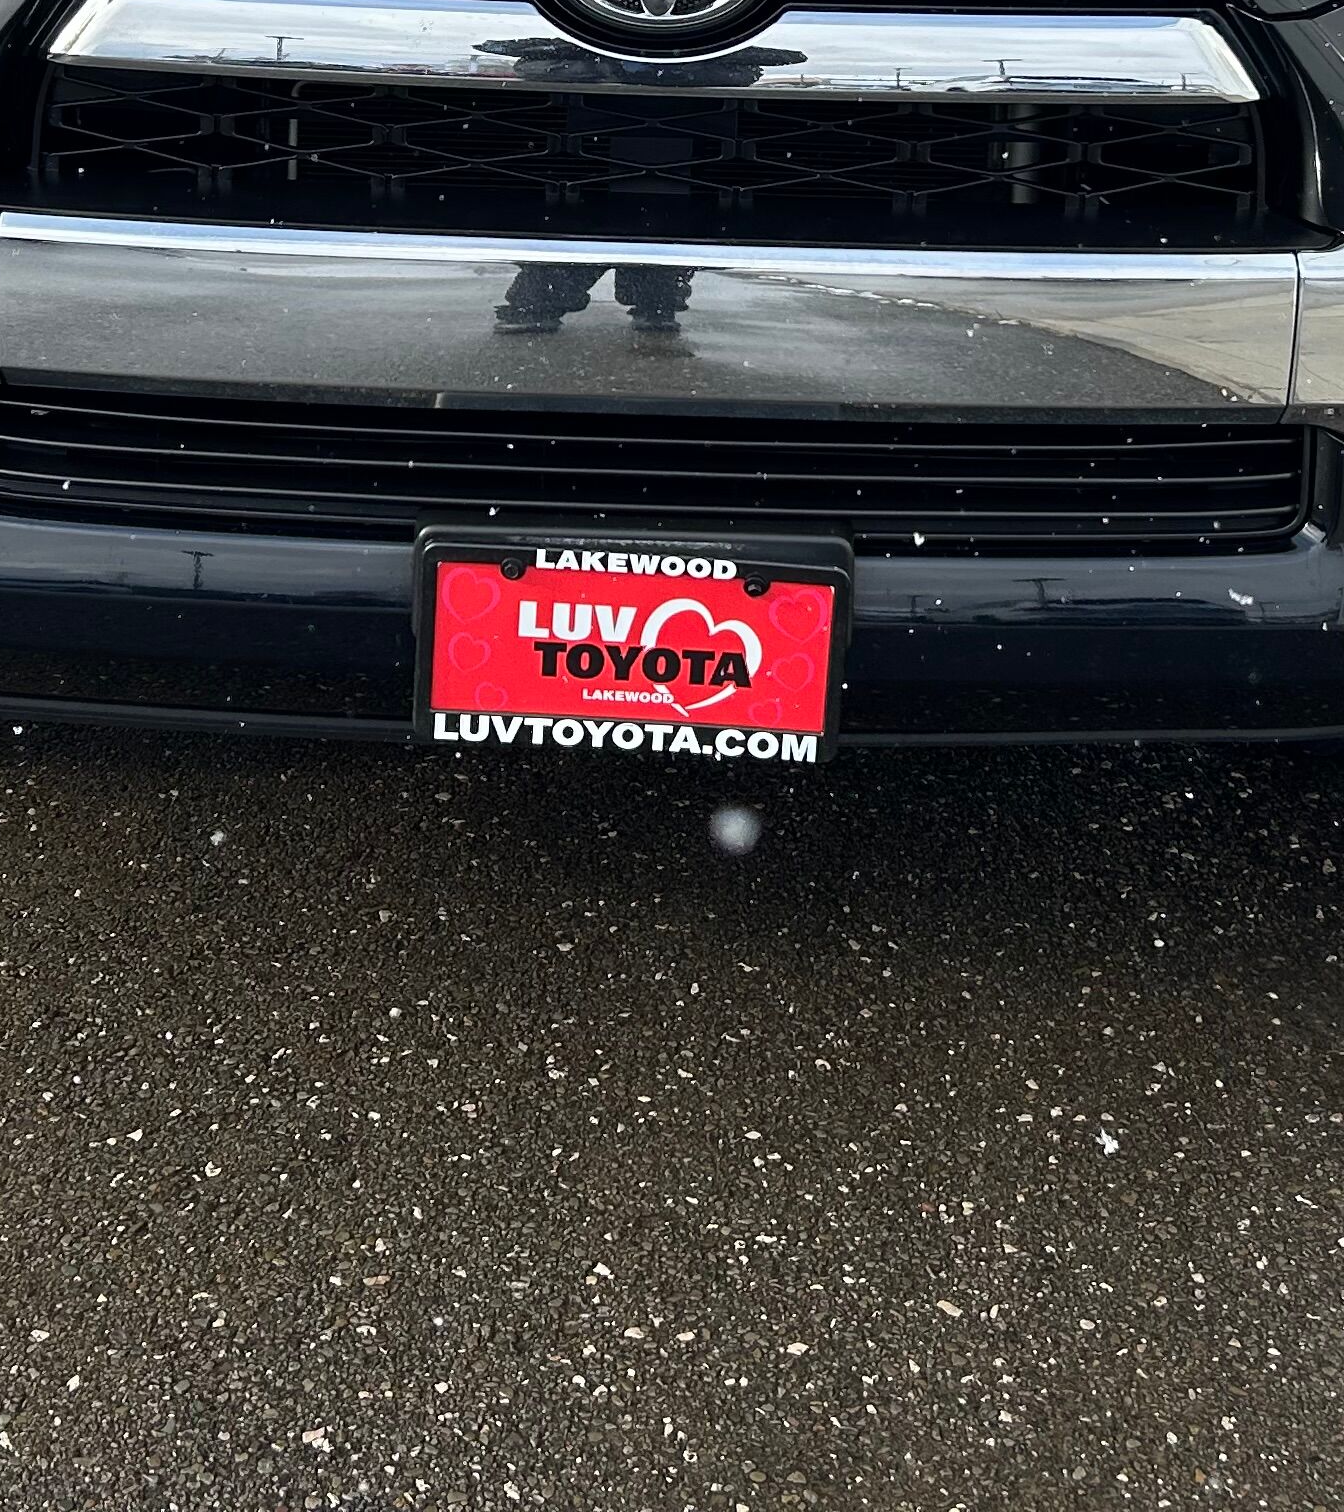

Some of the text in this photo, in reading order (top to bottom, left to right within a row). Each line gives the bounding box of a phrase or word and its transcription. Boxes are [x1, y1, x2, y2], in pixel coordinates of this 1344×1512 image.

[535, 548, 738, 580] LAKEWOOD
[517, 600, 638, 643] LUV
[533, 641, 753, 688] TOYOTA
[582, 688, 675, 704] LAKEWOOD
[433, 712, 818, 763] LUVTOYOTA.COM
